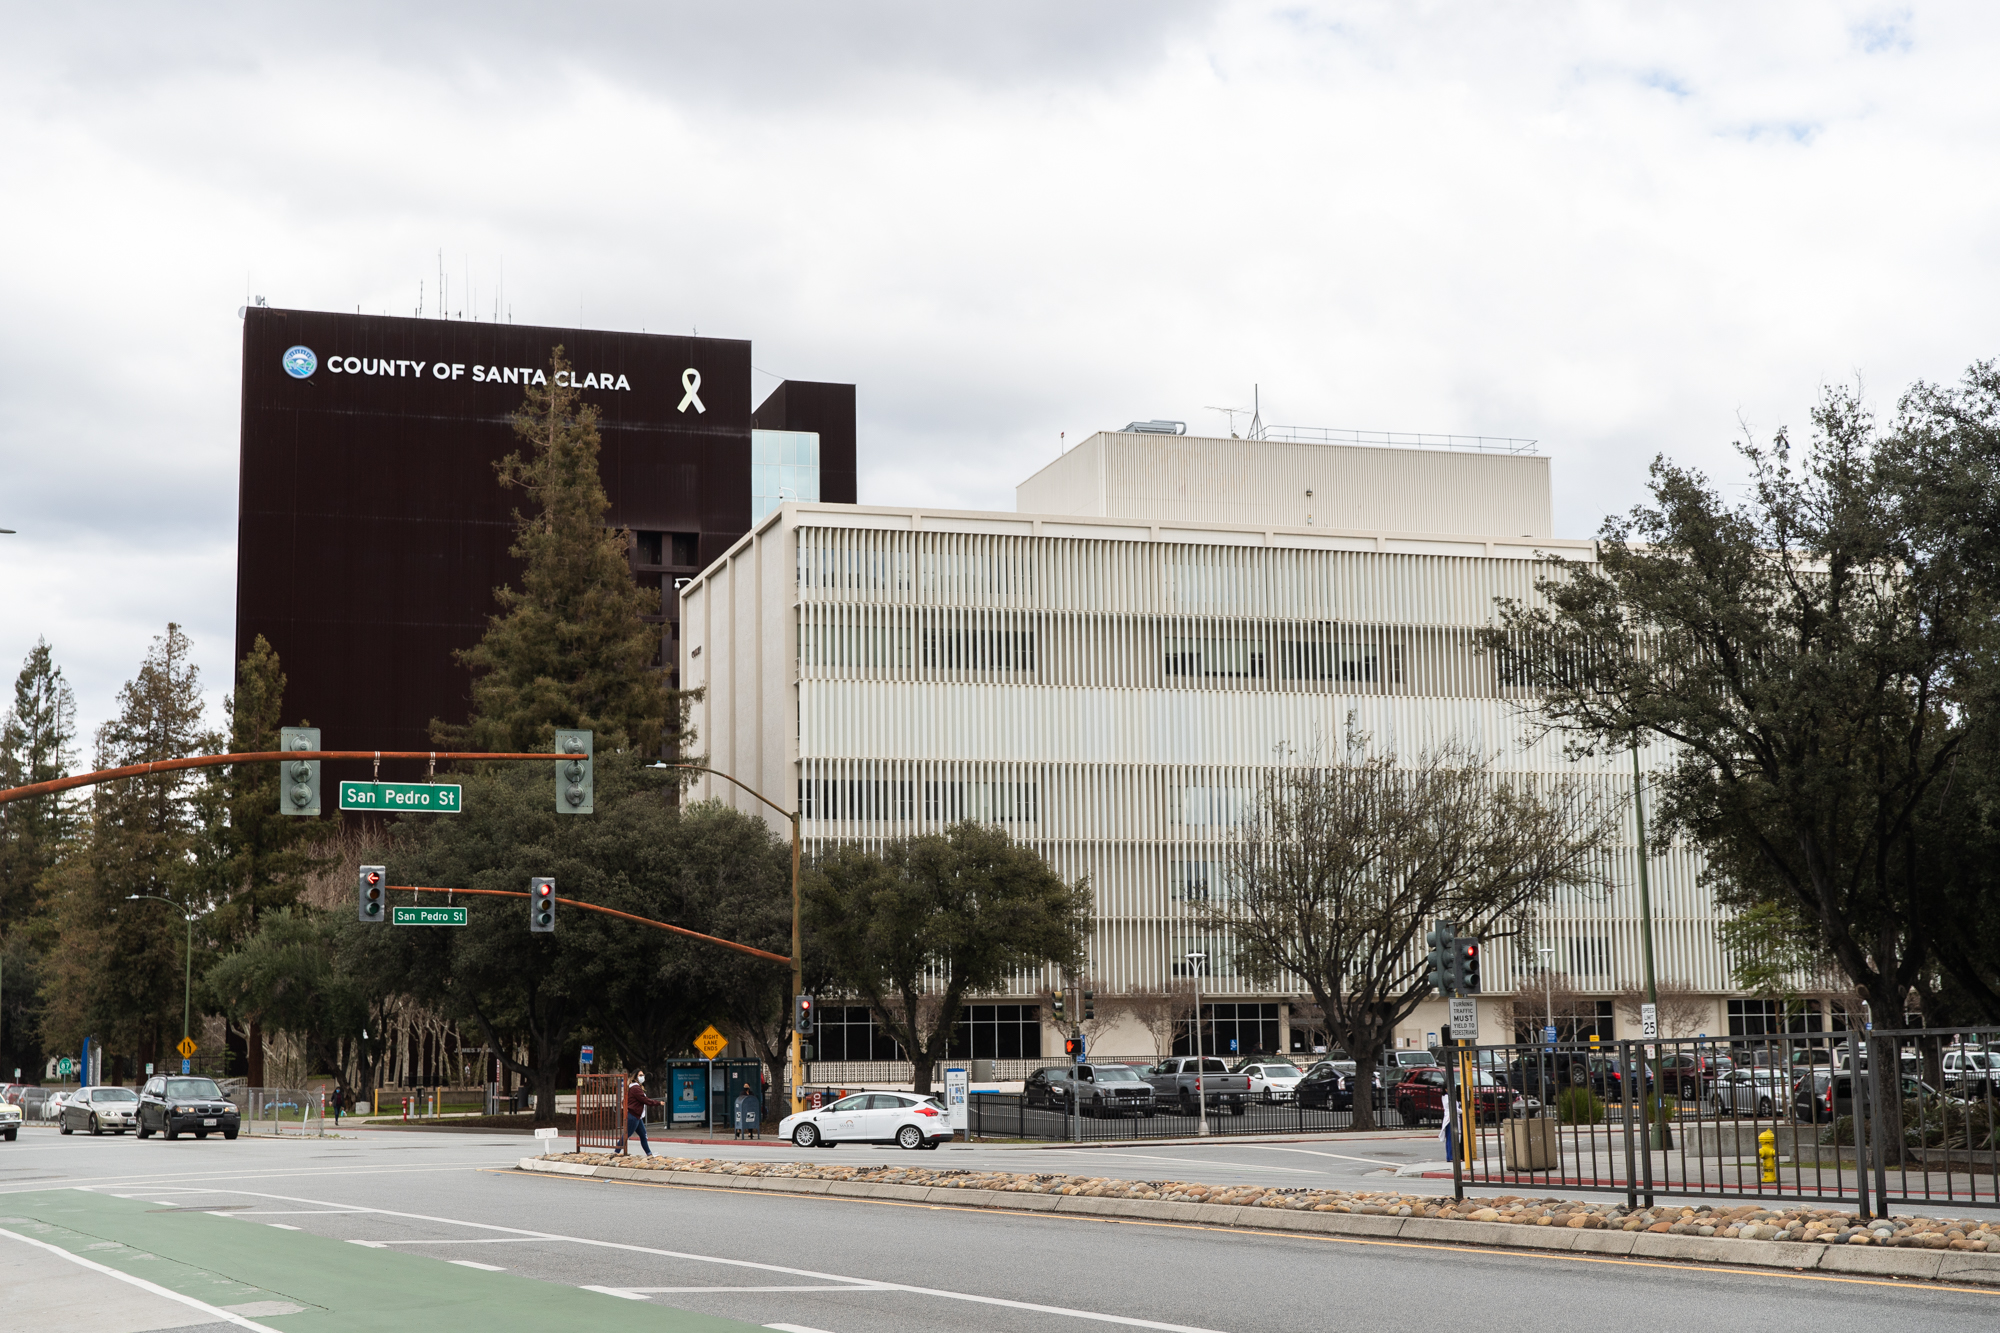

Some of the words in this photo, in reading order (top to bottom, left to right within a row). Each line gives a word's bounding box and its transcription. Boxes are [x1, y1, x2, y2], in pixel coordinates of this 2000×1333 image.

[327, 355, 426, 378] COUNTY
[432, 362, 465, 381] OF
[472, 365, 547, 386] SANTA
[554, 370, 631, 391] CLARA
[347, 788, 376, 803] San
[385, 789, 430, 805] Pedro
[439, 791, 455, 805] St
[397, 911, 415, 921] San
[421, 911, 449, 921] Pedro
[453, 911, 463, 921] St
[1644, 1022, 1655, 1034] 25
